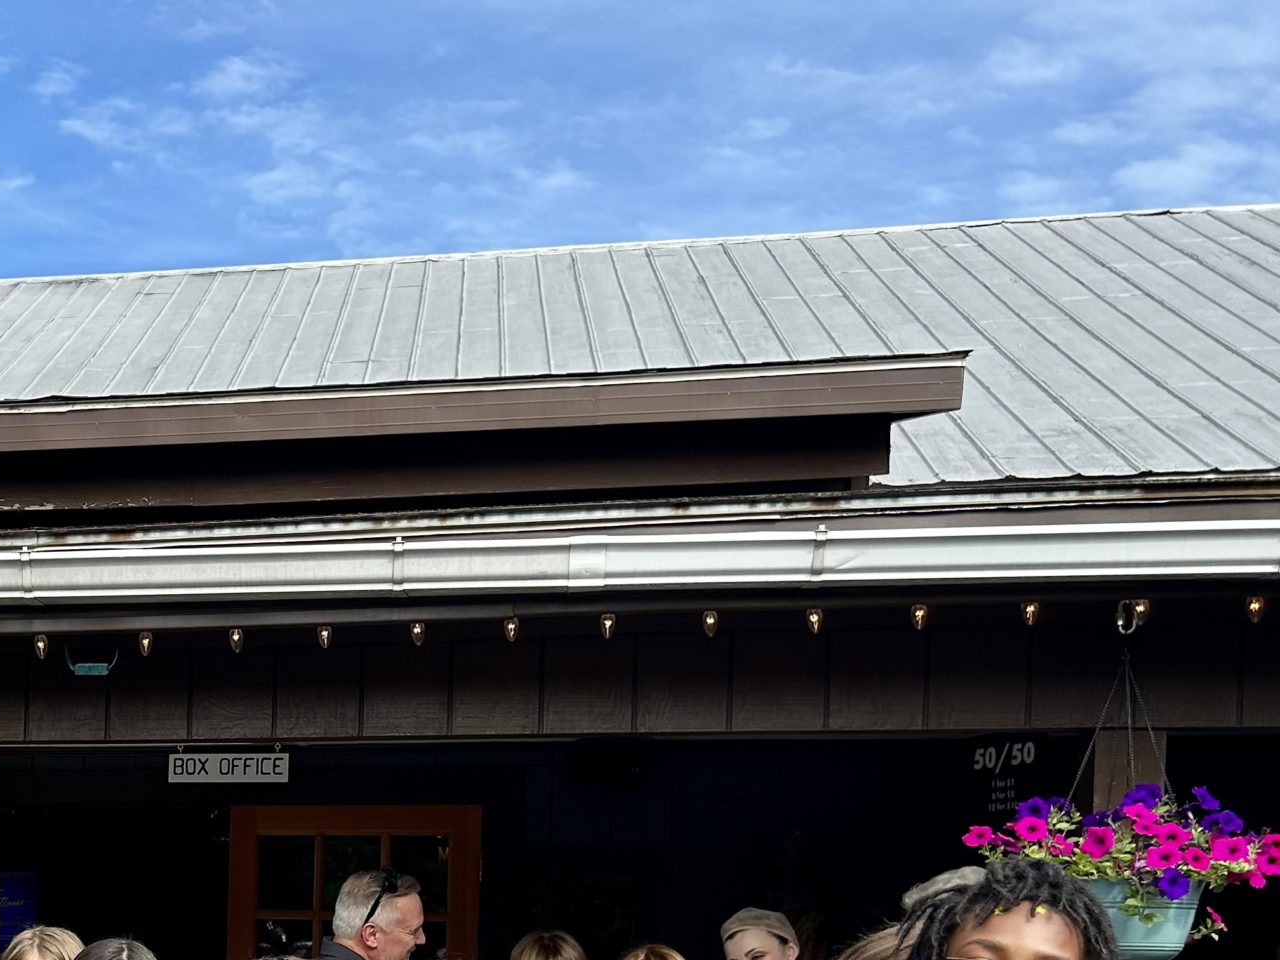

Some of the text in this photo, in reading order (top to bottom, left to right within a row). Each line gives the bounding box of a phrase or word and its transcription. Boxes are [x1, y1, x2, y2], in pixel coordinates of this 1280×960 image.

[173, 756, 285, 776] BOX OFFICE
[973, 741, 1035, 774] 50/50
